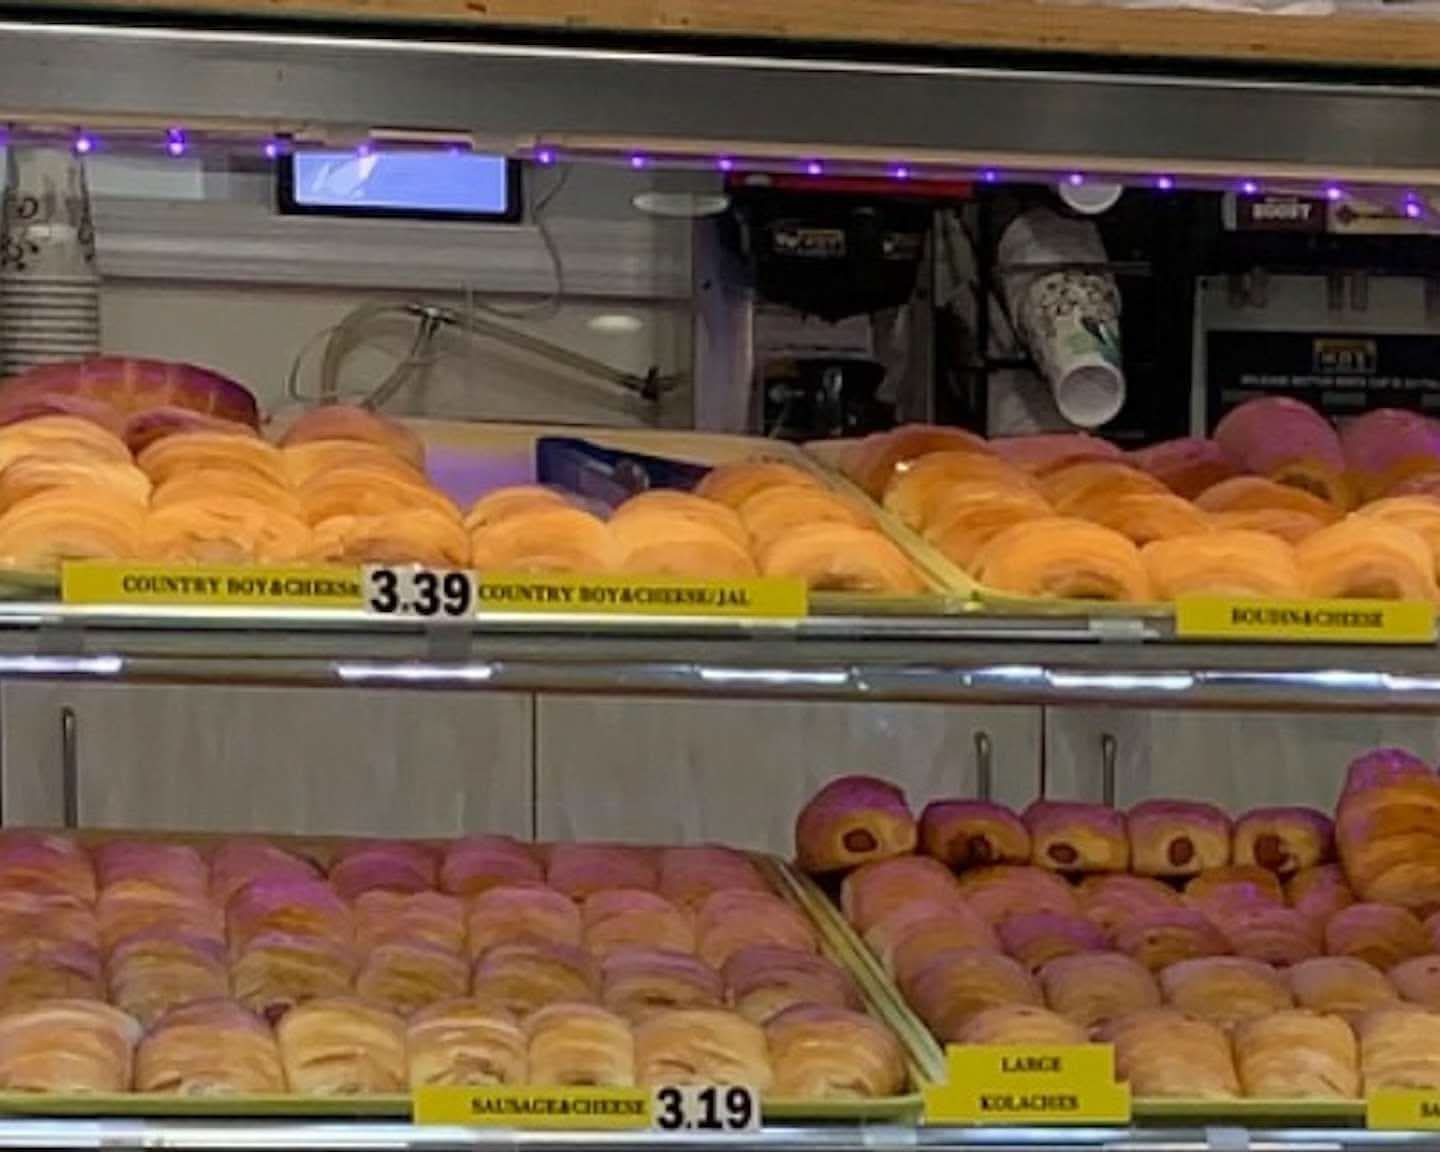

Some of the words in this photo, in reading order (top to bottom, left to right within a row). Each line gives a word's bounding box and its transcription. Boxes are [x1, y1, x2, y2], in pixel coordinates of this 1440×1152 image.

[123, 574, 219, 594] COUNTRY
[370, 569, 471, 616] 3.39
[478, 584, 573, 602] COUNTRY
[1232, 607, 1383, 628] BOUDIN&CHEESE
[1001, 1057, 1061, 1072] LARGE
[472, 1098, 645, 1115] SAUSAGE&CHEESE
[657, 1087, 752, 1130] 3.19
[981, 1096, 1078, 1111] KOLACHES
